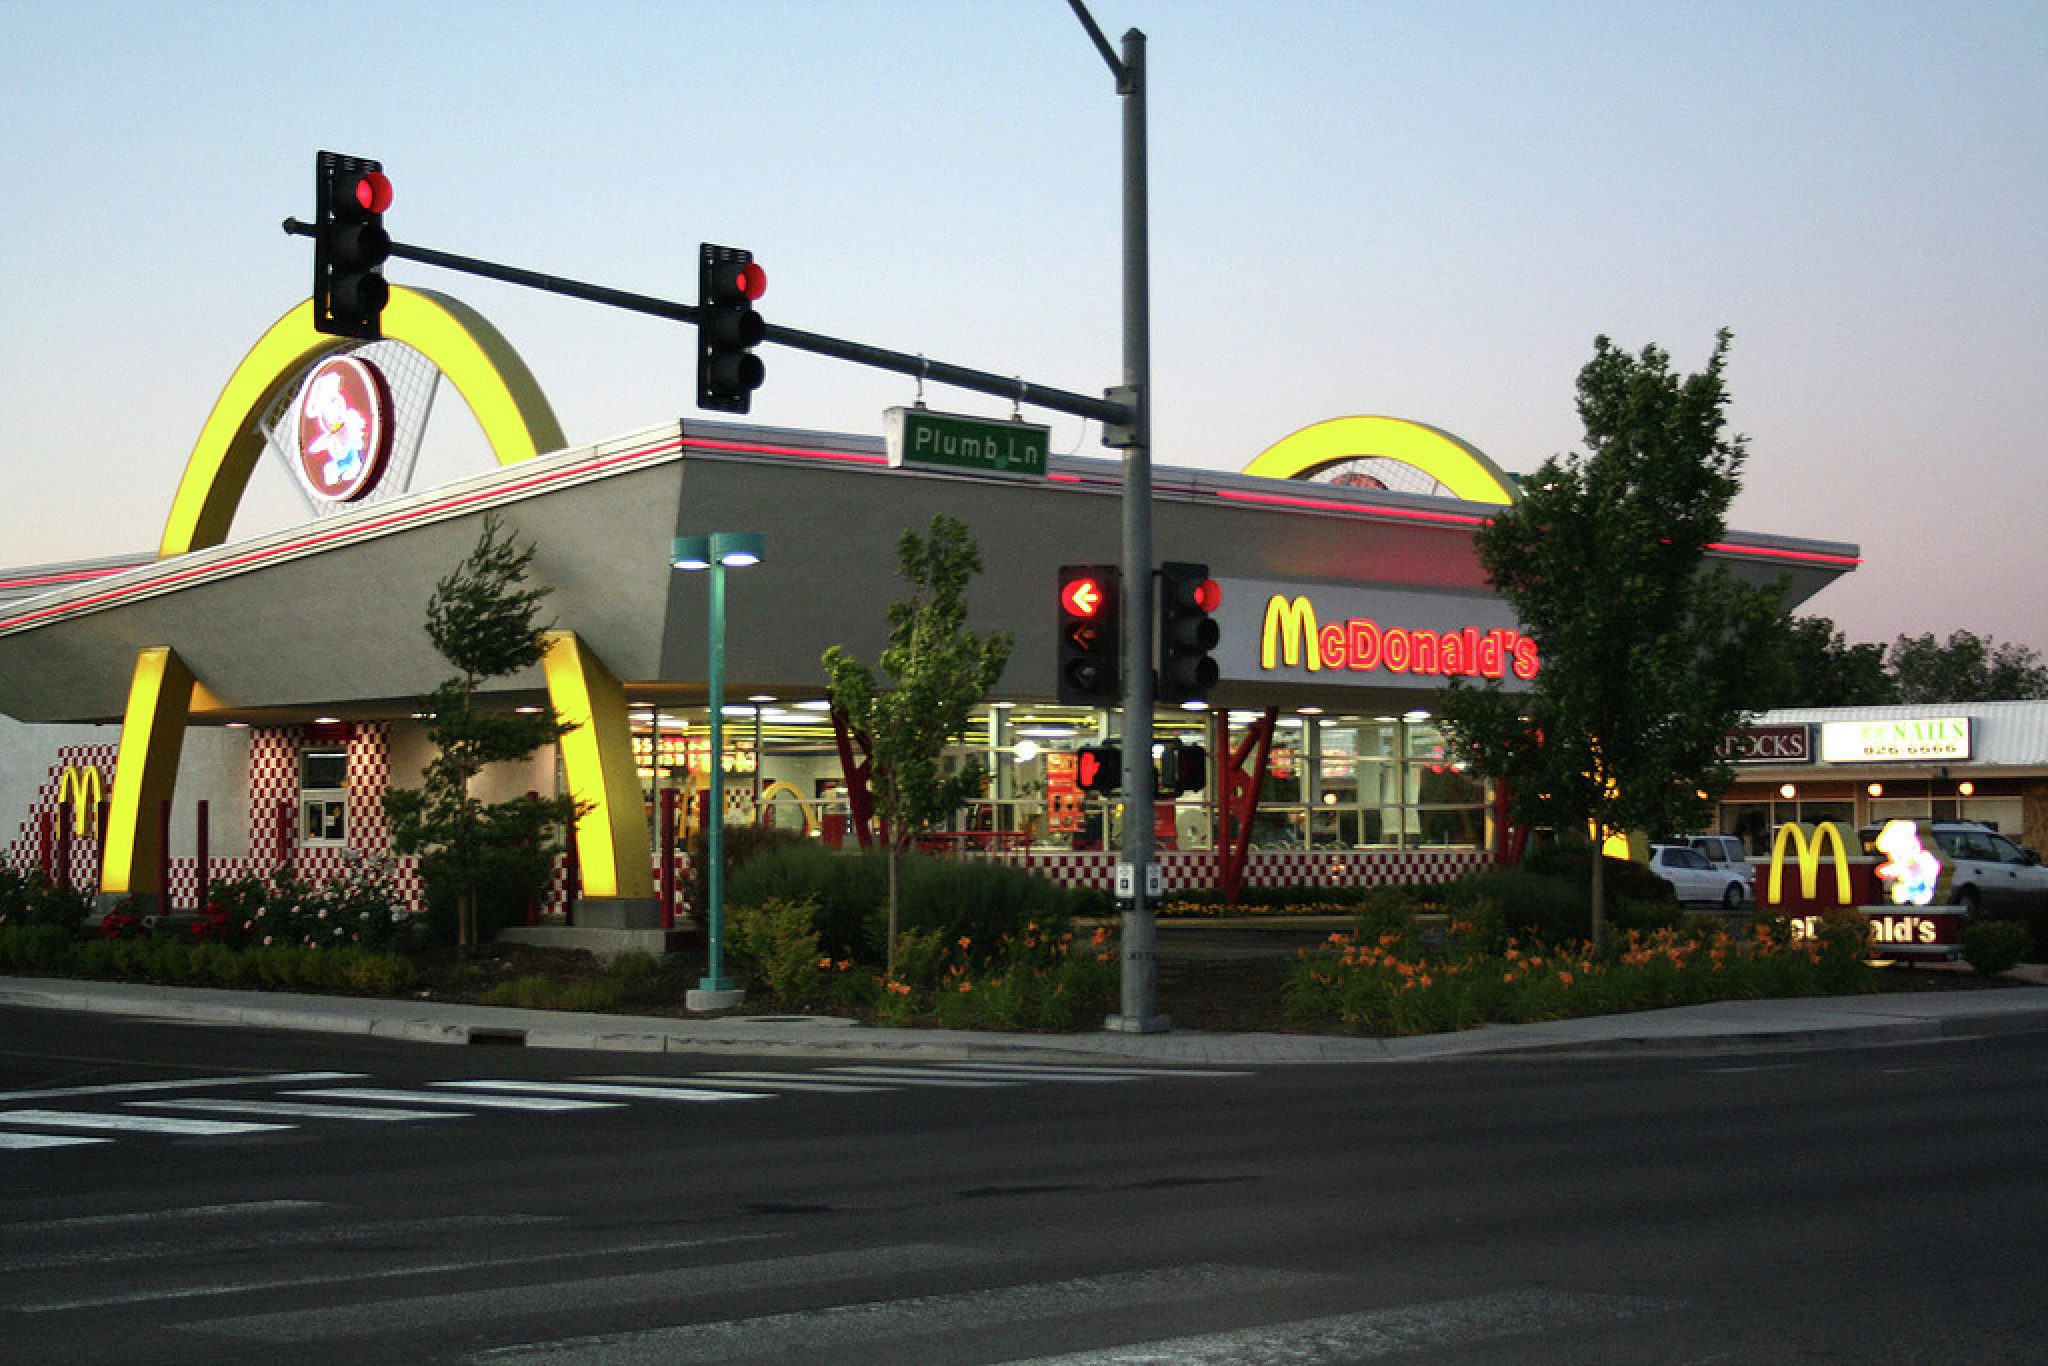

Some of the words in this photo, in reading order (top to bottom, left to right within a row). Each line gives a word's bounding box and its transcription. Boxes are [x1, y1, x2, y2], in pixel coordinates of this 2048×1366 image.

[915, 425, 998, 460] Plumb
[1008, 437, 1038, 465] Ln
[1261, 594, 1540, 680] McDonald's
[1893, 721, 1964, 741] NAILS
